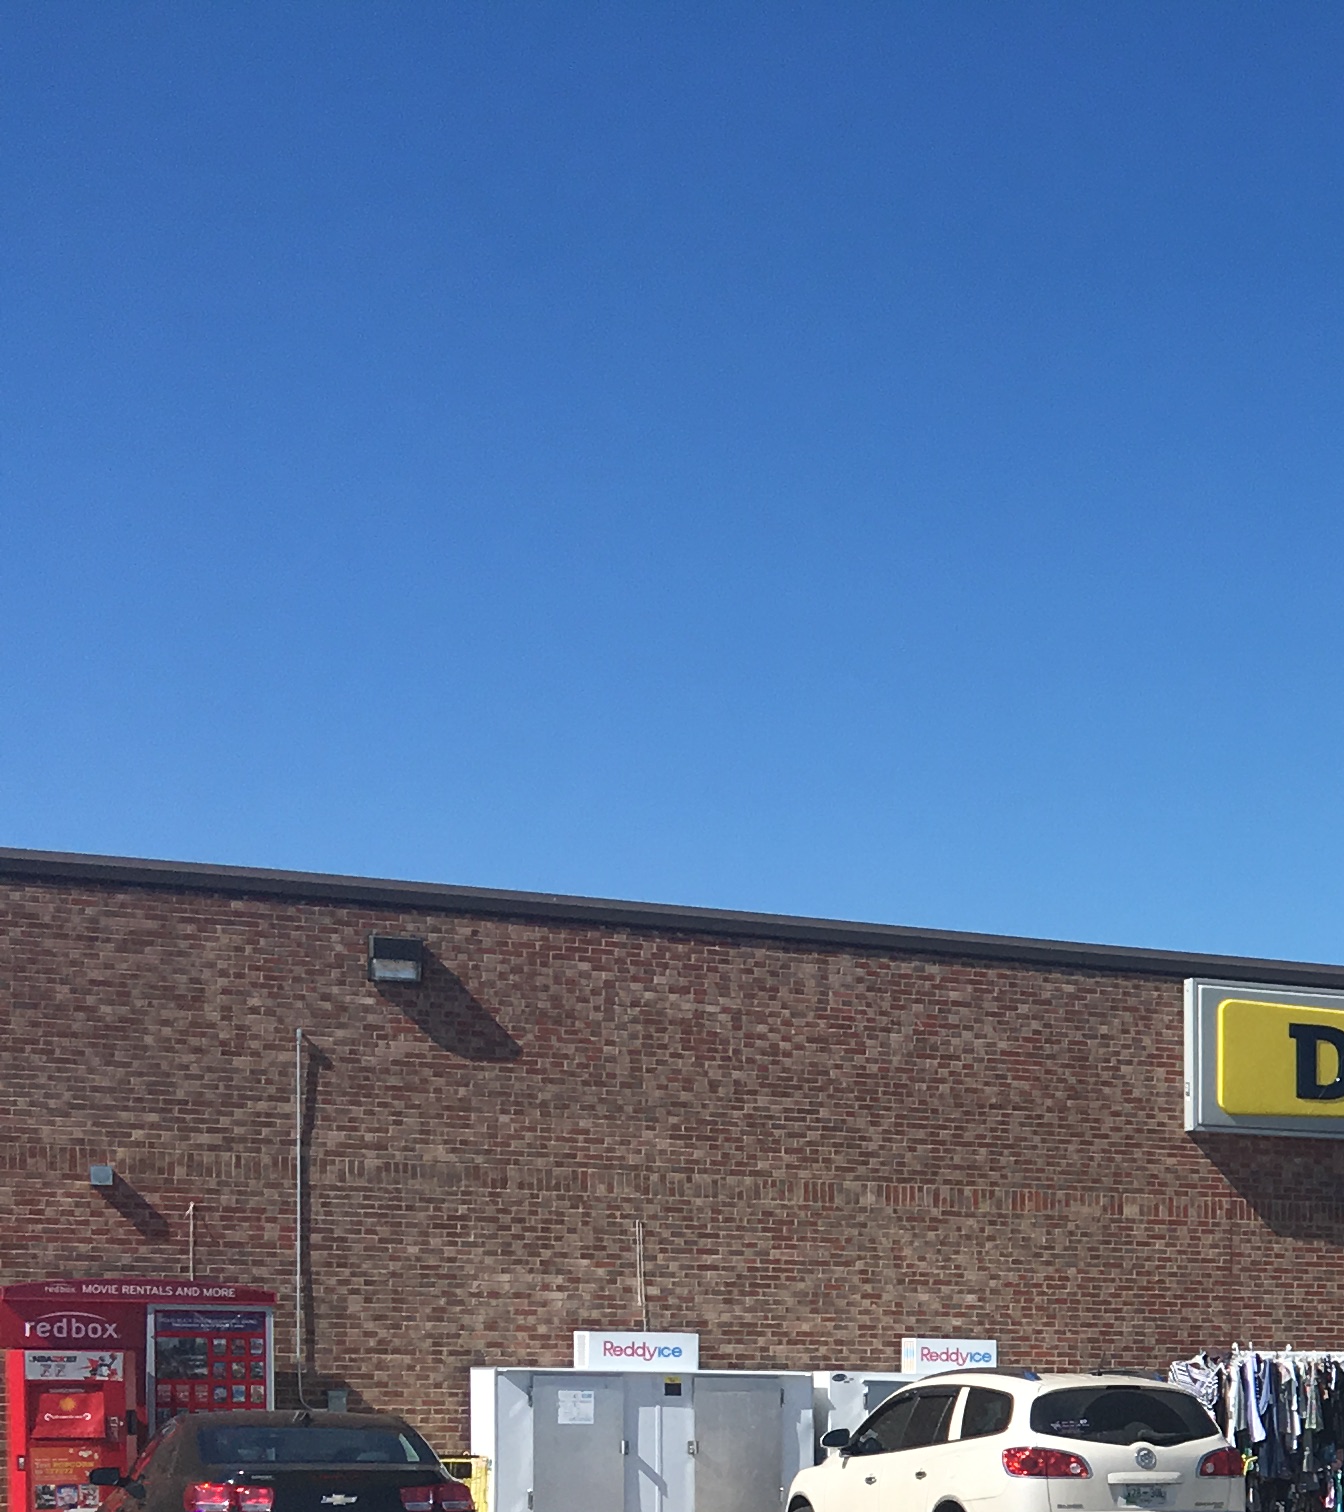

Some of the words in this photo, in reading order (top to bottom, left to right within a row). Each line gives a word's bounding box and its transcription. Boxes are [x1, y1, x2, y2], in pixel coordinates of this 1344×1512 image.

[82, 1284, 118, 1294] MOVIE
[122, 1285, 173, 1296] RENTALS
[175, 1286, 200, 1296] AND
[202, 1287, 236, 1297] MORE
[24, 1318, 119, 1339] redbox
